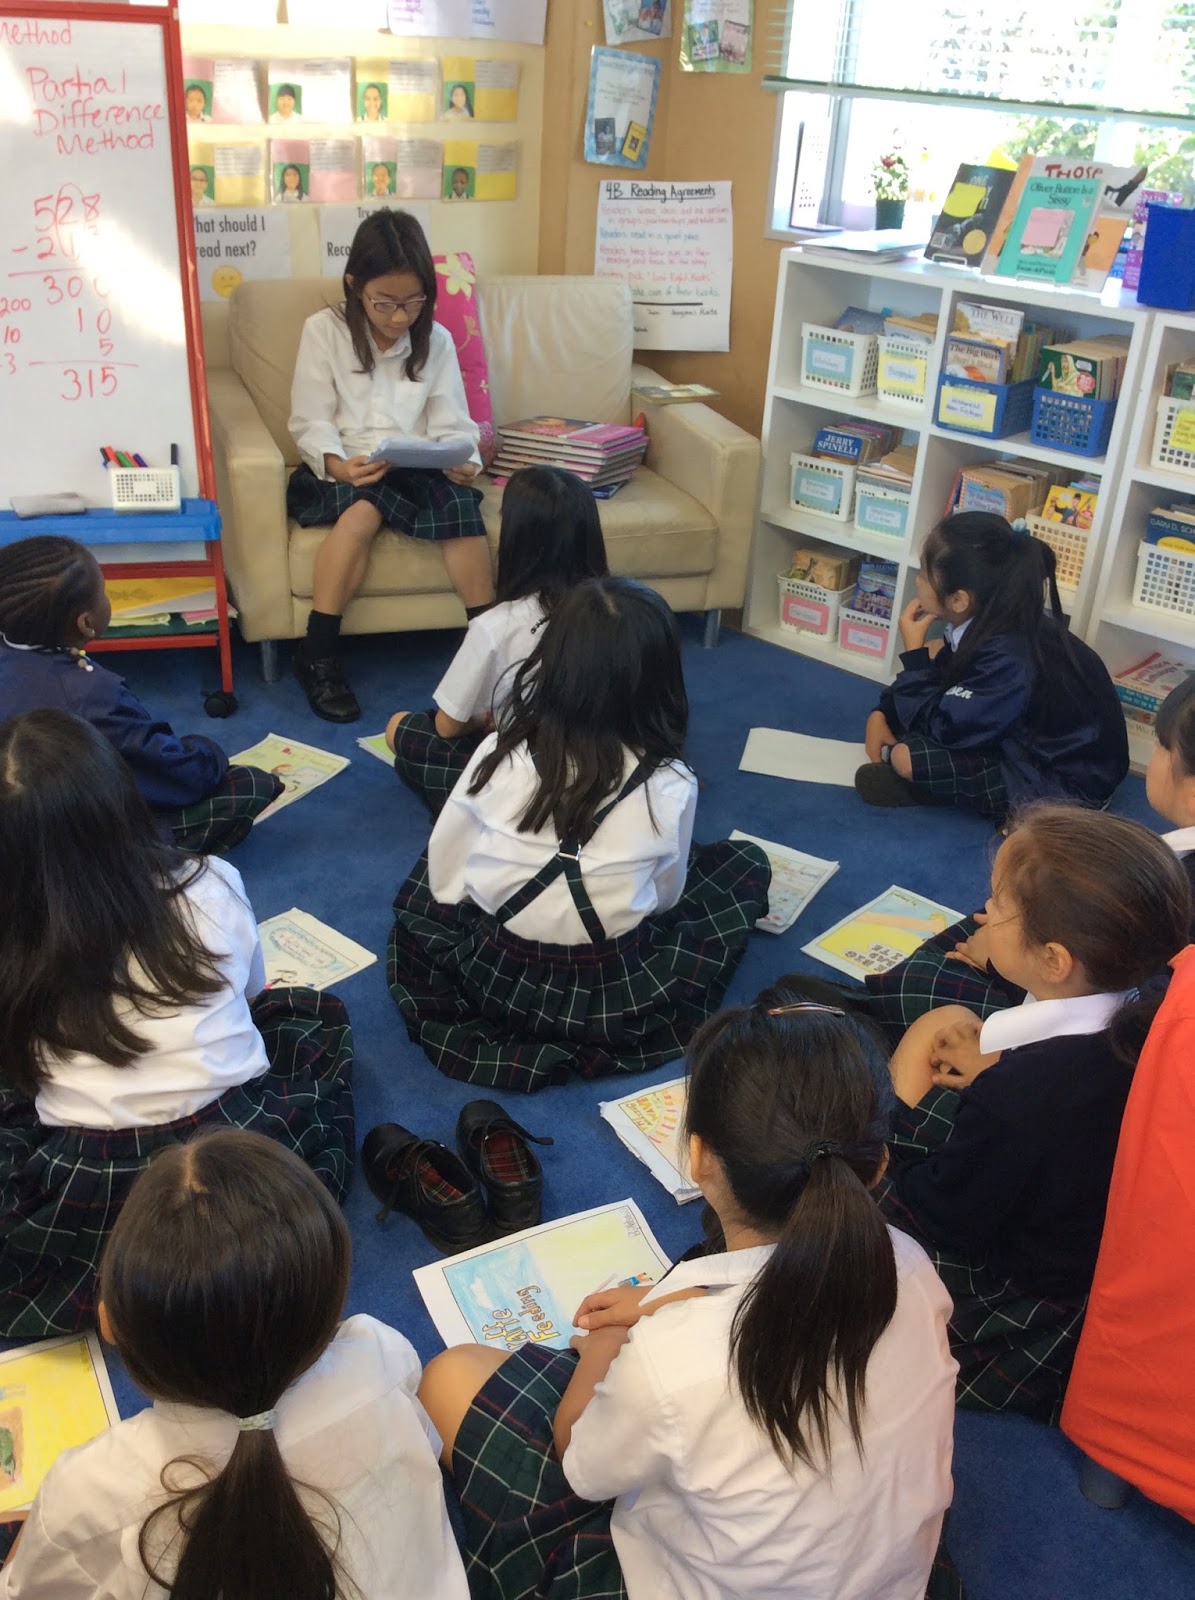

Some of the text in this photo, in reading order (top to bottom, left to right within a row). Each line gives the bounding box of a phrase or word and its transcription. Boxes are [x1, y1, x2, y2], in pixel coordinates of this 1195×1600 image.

[33, 97, 165, 137] Difference
[57, 128, 154, 155] Method
[606, 182, 716, 203] 4B Reading Agreements
[1031, 182, 1053, 192] Oliver
[1055, 184, 1079, 194] Button
[1048, 193, 1071, 207] Sissy
[194, 215, 215, 233] hat
[219, 214, 257, 232] should
[225, 240, 256, 257] next?
[327, 242, 351, 256] Reco
[972, 309, 1015, 324] THE WELL
[951, 344, 965, 353] The
[980, 349, 999, 360] Wave
[61, 366, 118, 401] 315
[817, 440, 859, 456] SPINELLI
[825, 434, 854, 447] JERRY
[1150, 518, 1170, 529] GARY
[1180, 525, 1195, 534] SCH
[857, 590, 893, 607] ZOMBI
[871, 944, 903, 960] ITE
[516, 1285, 561, 1343] Feeding
[482, 1308, 528, 1350] raffe
